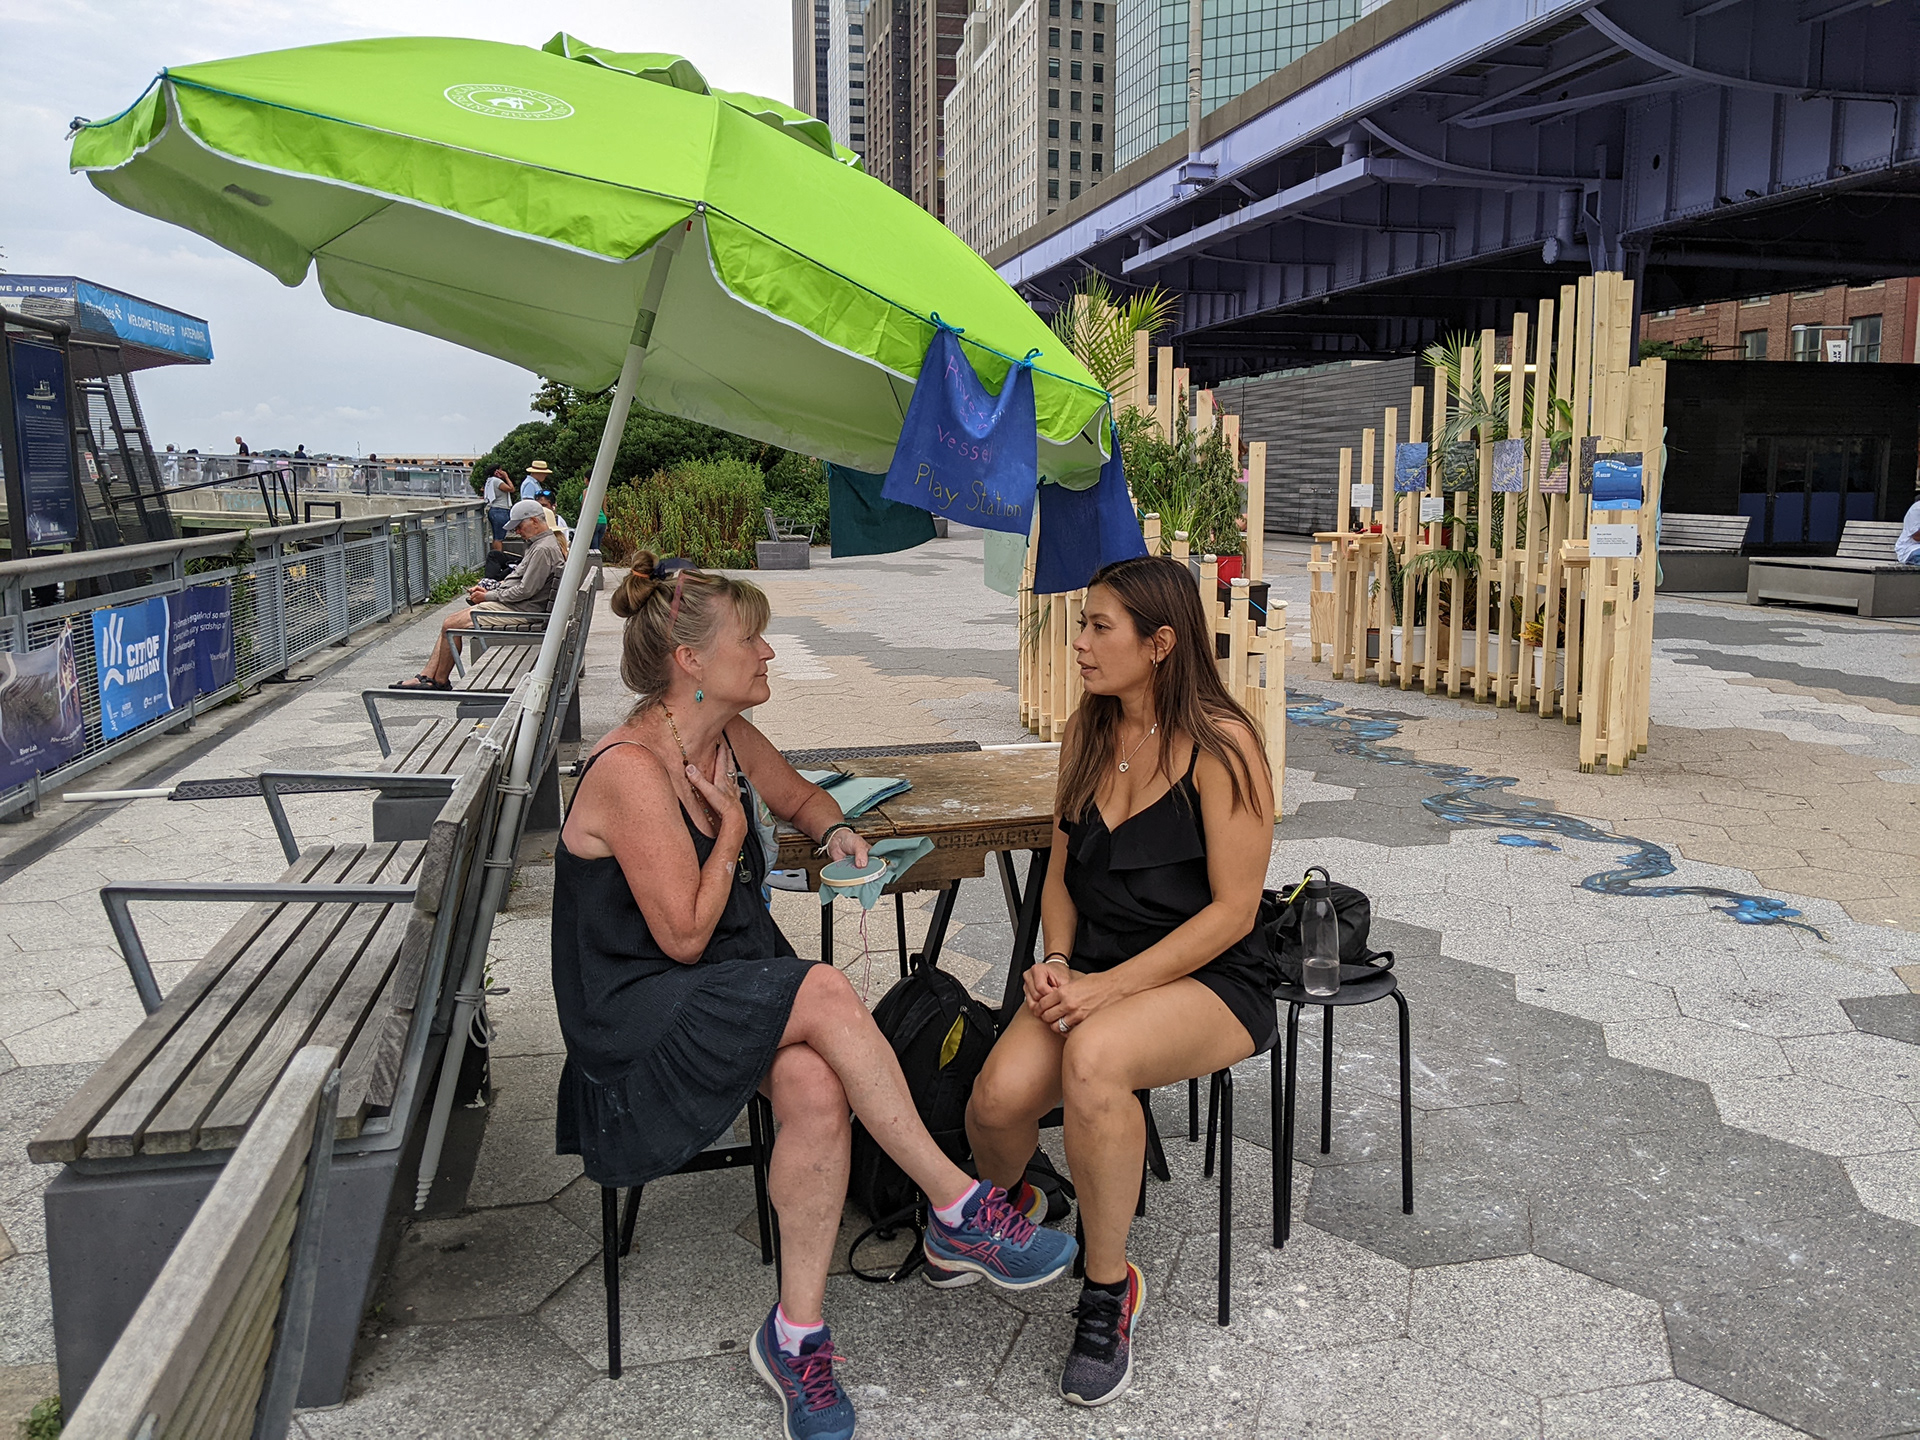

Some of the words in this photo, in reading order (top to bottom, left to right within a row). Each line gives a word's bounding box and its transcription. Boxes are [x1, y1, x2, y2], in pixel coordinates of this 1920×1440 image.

[127, 313, 152, 331] WELCOME
[944, 355, 987, 419] River
[937, 424, 994, 463] Vessel
[914, 463, 959, 509] Play
[965, 480, 1023, 517] Station
[936, 828, 1042, 850] CREAMERY
